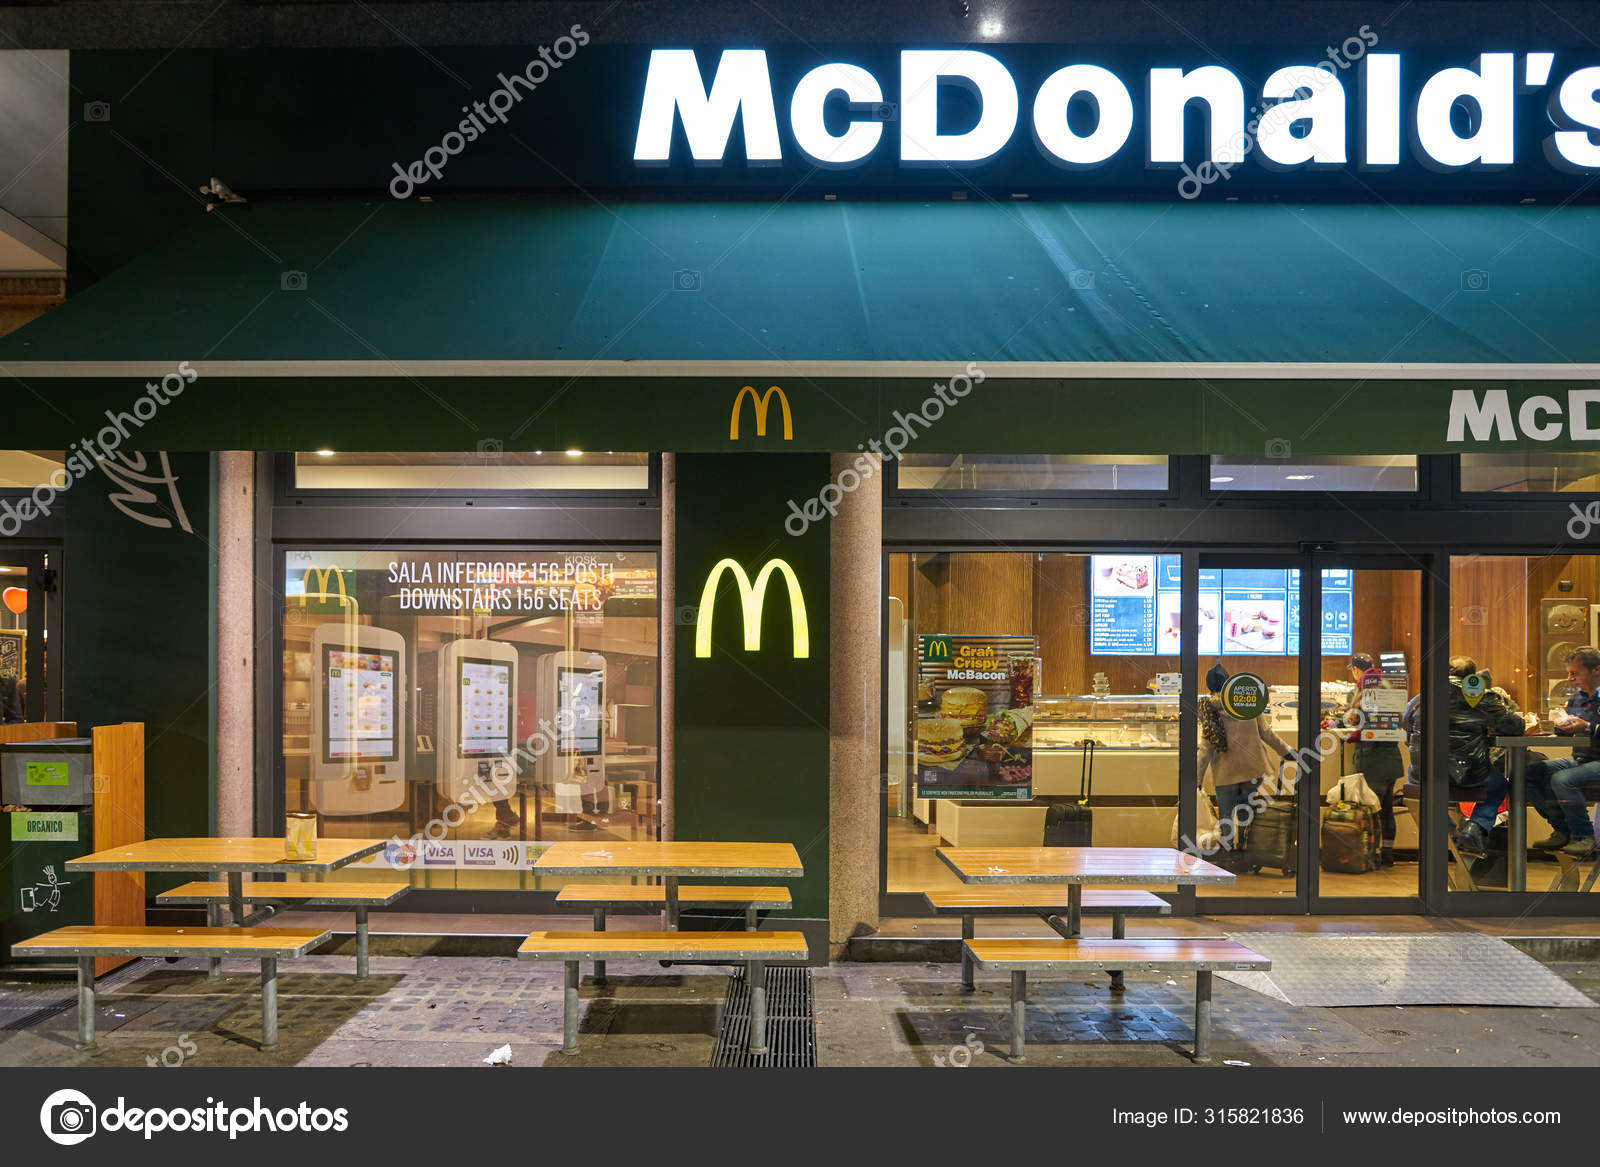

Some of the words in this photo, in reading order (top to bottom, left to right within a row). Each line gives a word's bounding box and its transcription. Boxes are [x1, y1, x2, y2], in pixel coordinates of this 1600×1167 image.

[388, 562, 432, 583] SALA
[438, 562, 527, 584] INFERIORE
[532, 563, 559, 584] 156
[564, 563, 614, 585] POSTI
[400, 588, 512, 610] DOWNSTAIRS
[517, 589, 544, 610] 156
[549, 589, 602, 610] SEATS
[960, 645, 994, 657] Gran
[954, 657, 999, 671] Crispy
[947, 669, 1006, 680] McBacon
[1233, 695, 1257, 703] 02:00
[27, 820, 63, 833] ORGANICO
[428, 847, 454, 857] VISA
[467, 848, 494, 857] VISA
